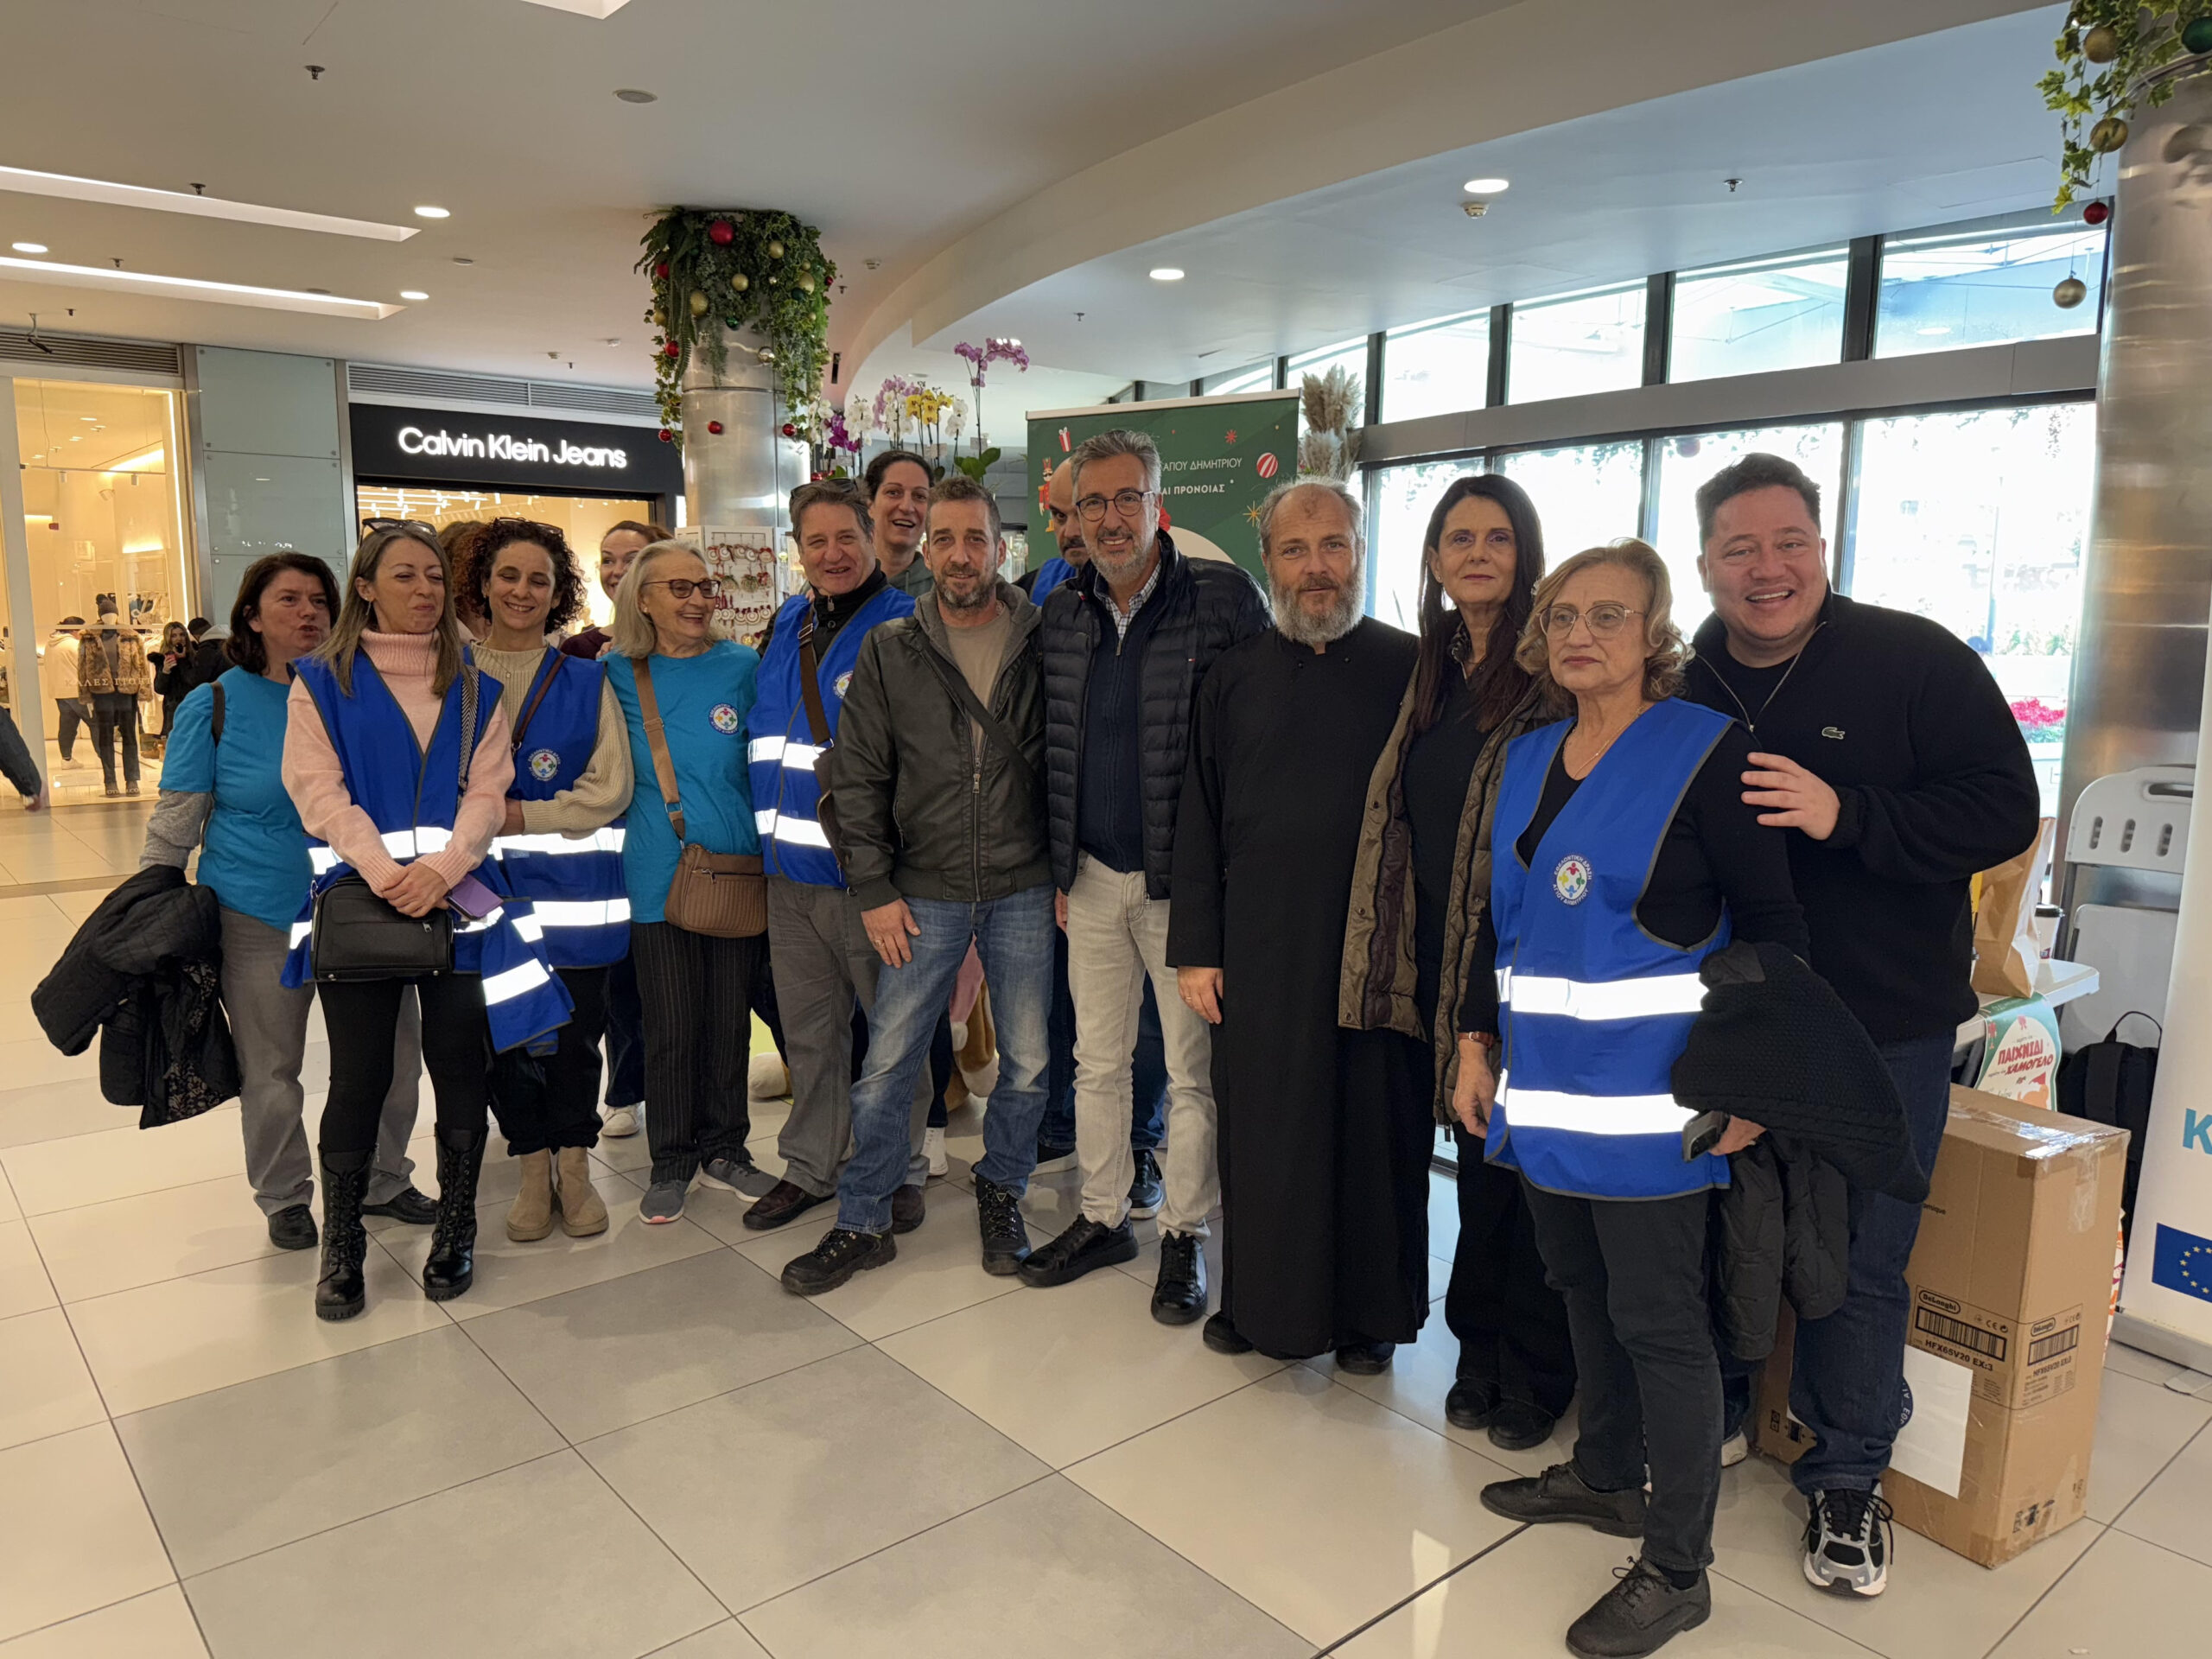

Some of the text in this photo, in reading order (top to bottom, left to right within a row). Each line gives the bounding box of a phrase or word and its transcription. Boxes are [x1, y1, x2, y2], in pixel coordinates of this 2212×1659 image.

[398, 427, 627, 468] Calvin Klein Jeans
[1190, 457, 1243, 470] ΔΗΜΗΤΡΙΟΥ
[1173, 484, 1226, 495] ΠΡΟΝΟΙΑΣ
[1998, 1039, 2044, 1065] ΠΑΙΧΝΙΔΙ
[2005, 1053, 2054, 1076] ΧΑΜΟΓΕΛΟ
